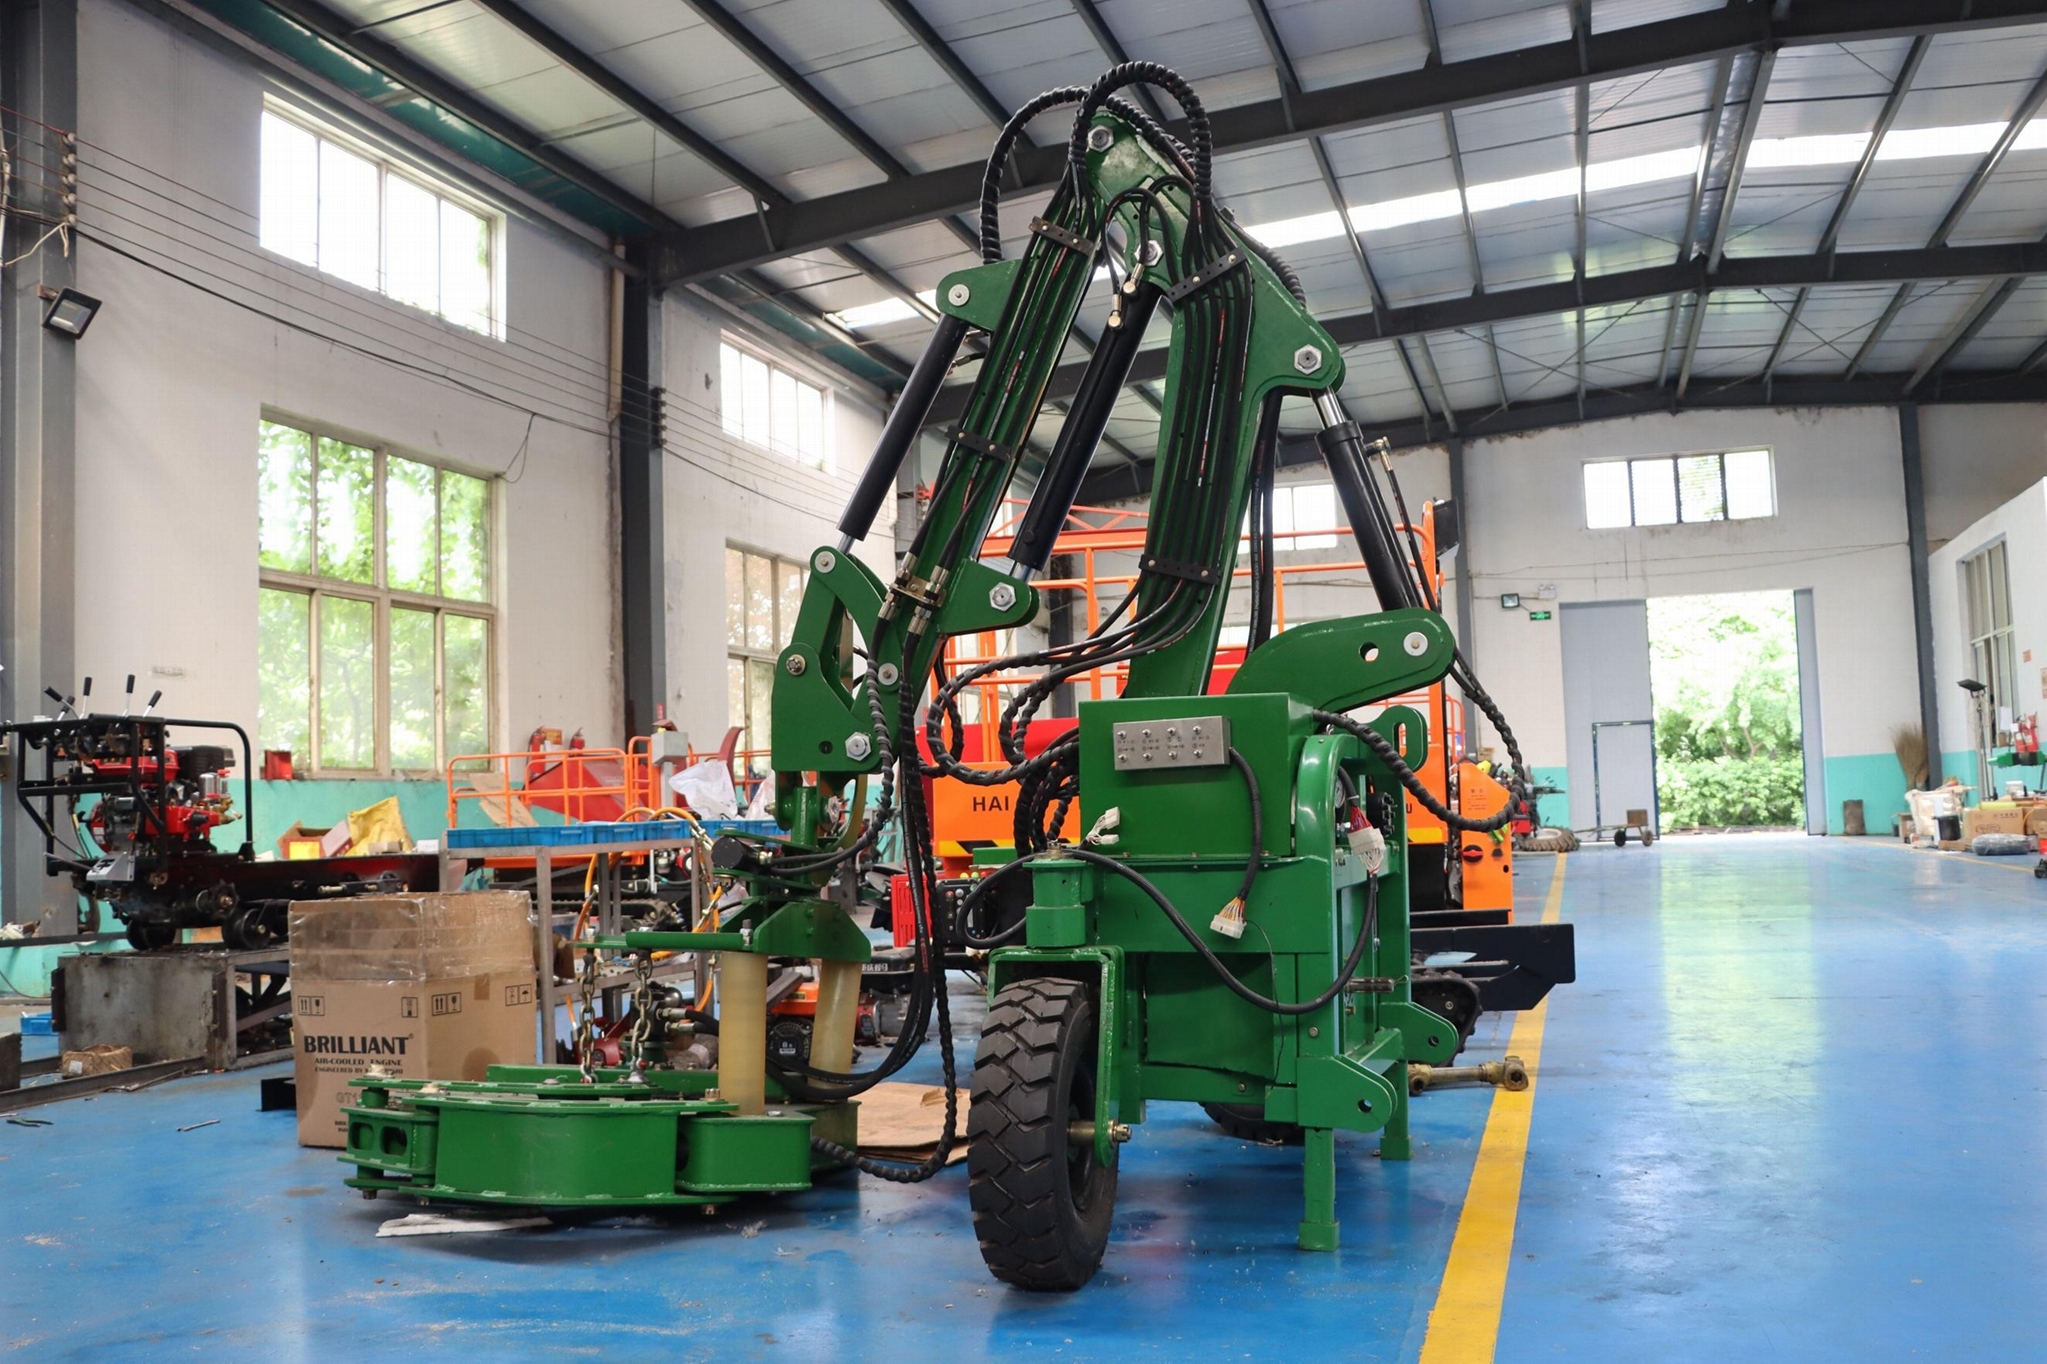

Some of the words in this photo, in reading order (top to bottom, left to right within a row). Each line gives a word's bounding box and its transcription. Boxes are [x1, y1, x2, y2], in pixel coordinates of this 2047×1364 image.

[303, 1035, 409, 1055] BRILLIANT
[315, 1057, 365, 1066] AIR-COOLED
[370, 1058, 402, 1067] ENGINE
